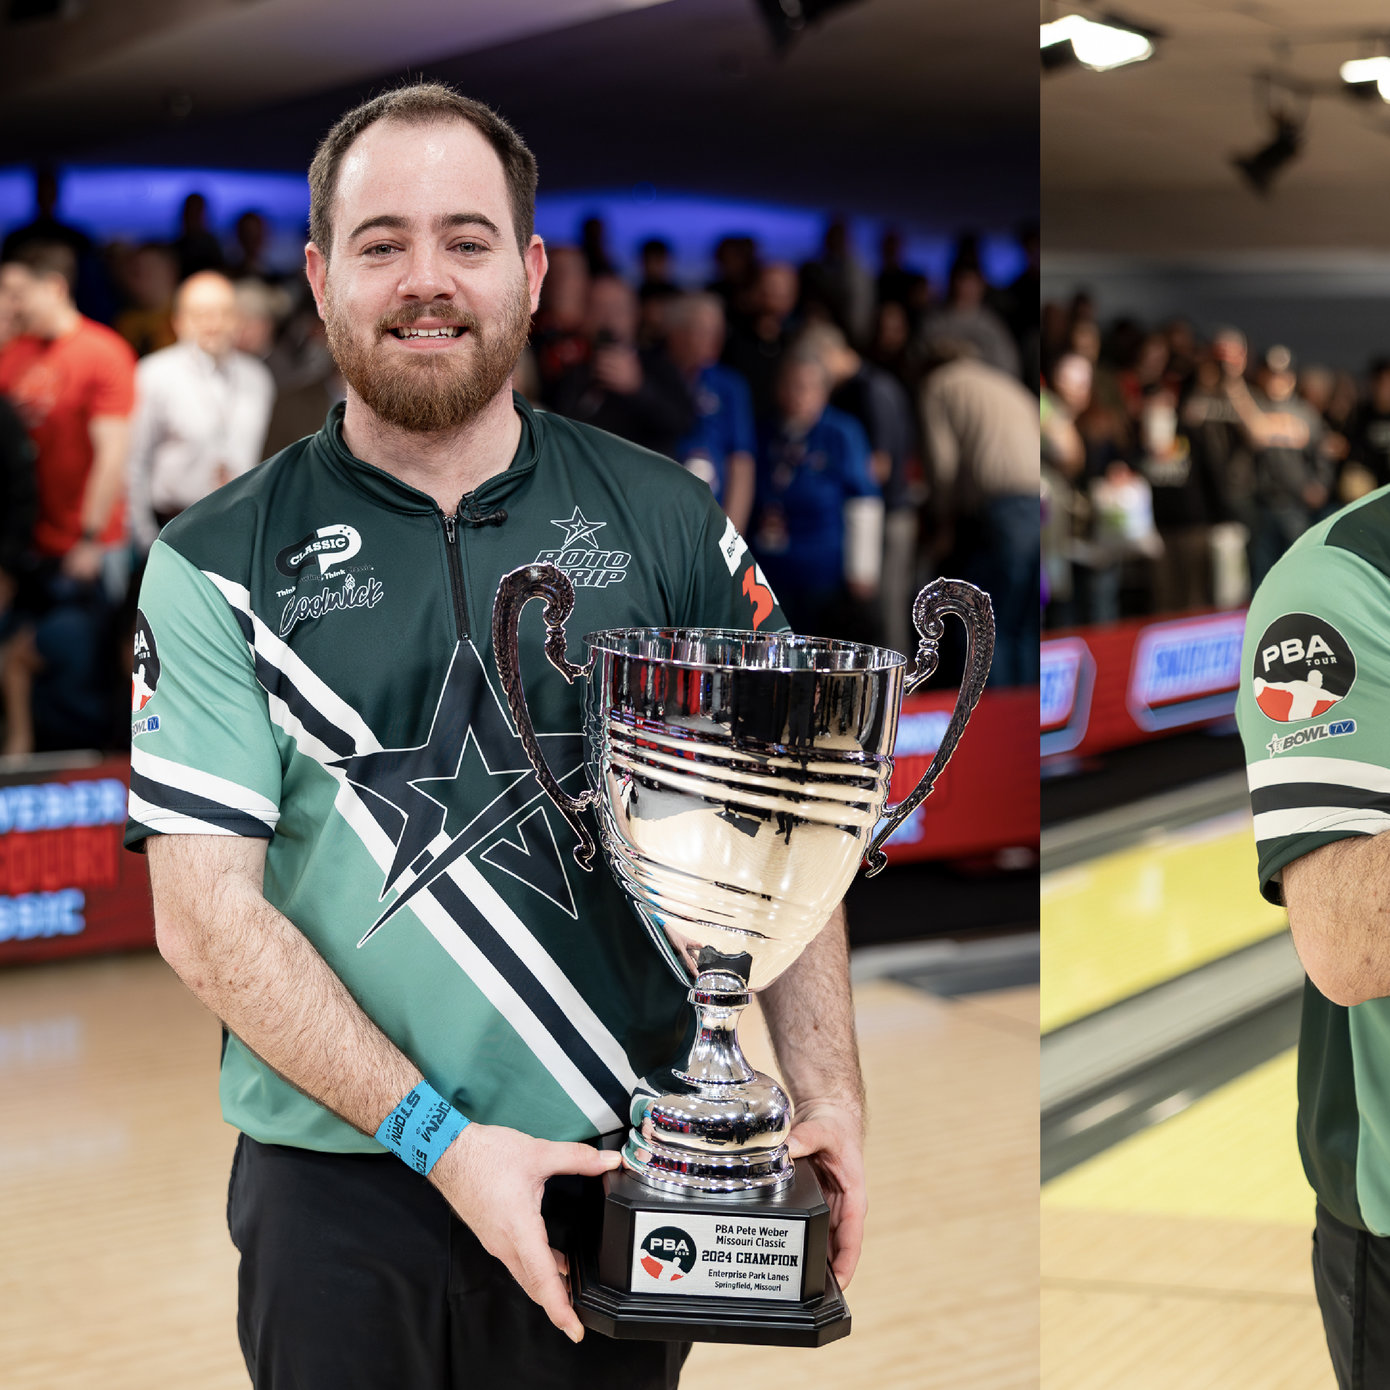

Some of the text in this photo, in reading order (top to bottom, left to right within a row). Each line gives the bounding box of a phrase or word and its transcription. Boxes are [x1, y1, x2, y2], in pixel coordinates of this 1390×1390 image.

[290, 537, 346, 566] CLASSIC
[535, 549, 632, 569] ROTO
[324, 569, 346, 580] Think
[560, 568, 627, 589] RIP
[1262, 634, 1335, 673] PBA
[1305, 656, 1338, 667] TOUR
[391, 1089, 421, 1147] STORM
[715, 1224, 789, 1238] PBA Pete Weber
[650, 1237, 690, 1252] PBA
[716, 1235, 787, 1249] Missouri Classic
[701, 1249, 799, 1267] 2024 CHAMPION
[708, 1268, 790, 1282] Enterprise Park Lanes
[714, 1281, 782, 1292] Springfield, Missouri
